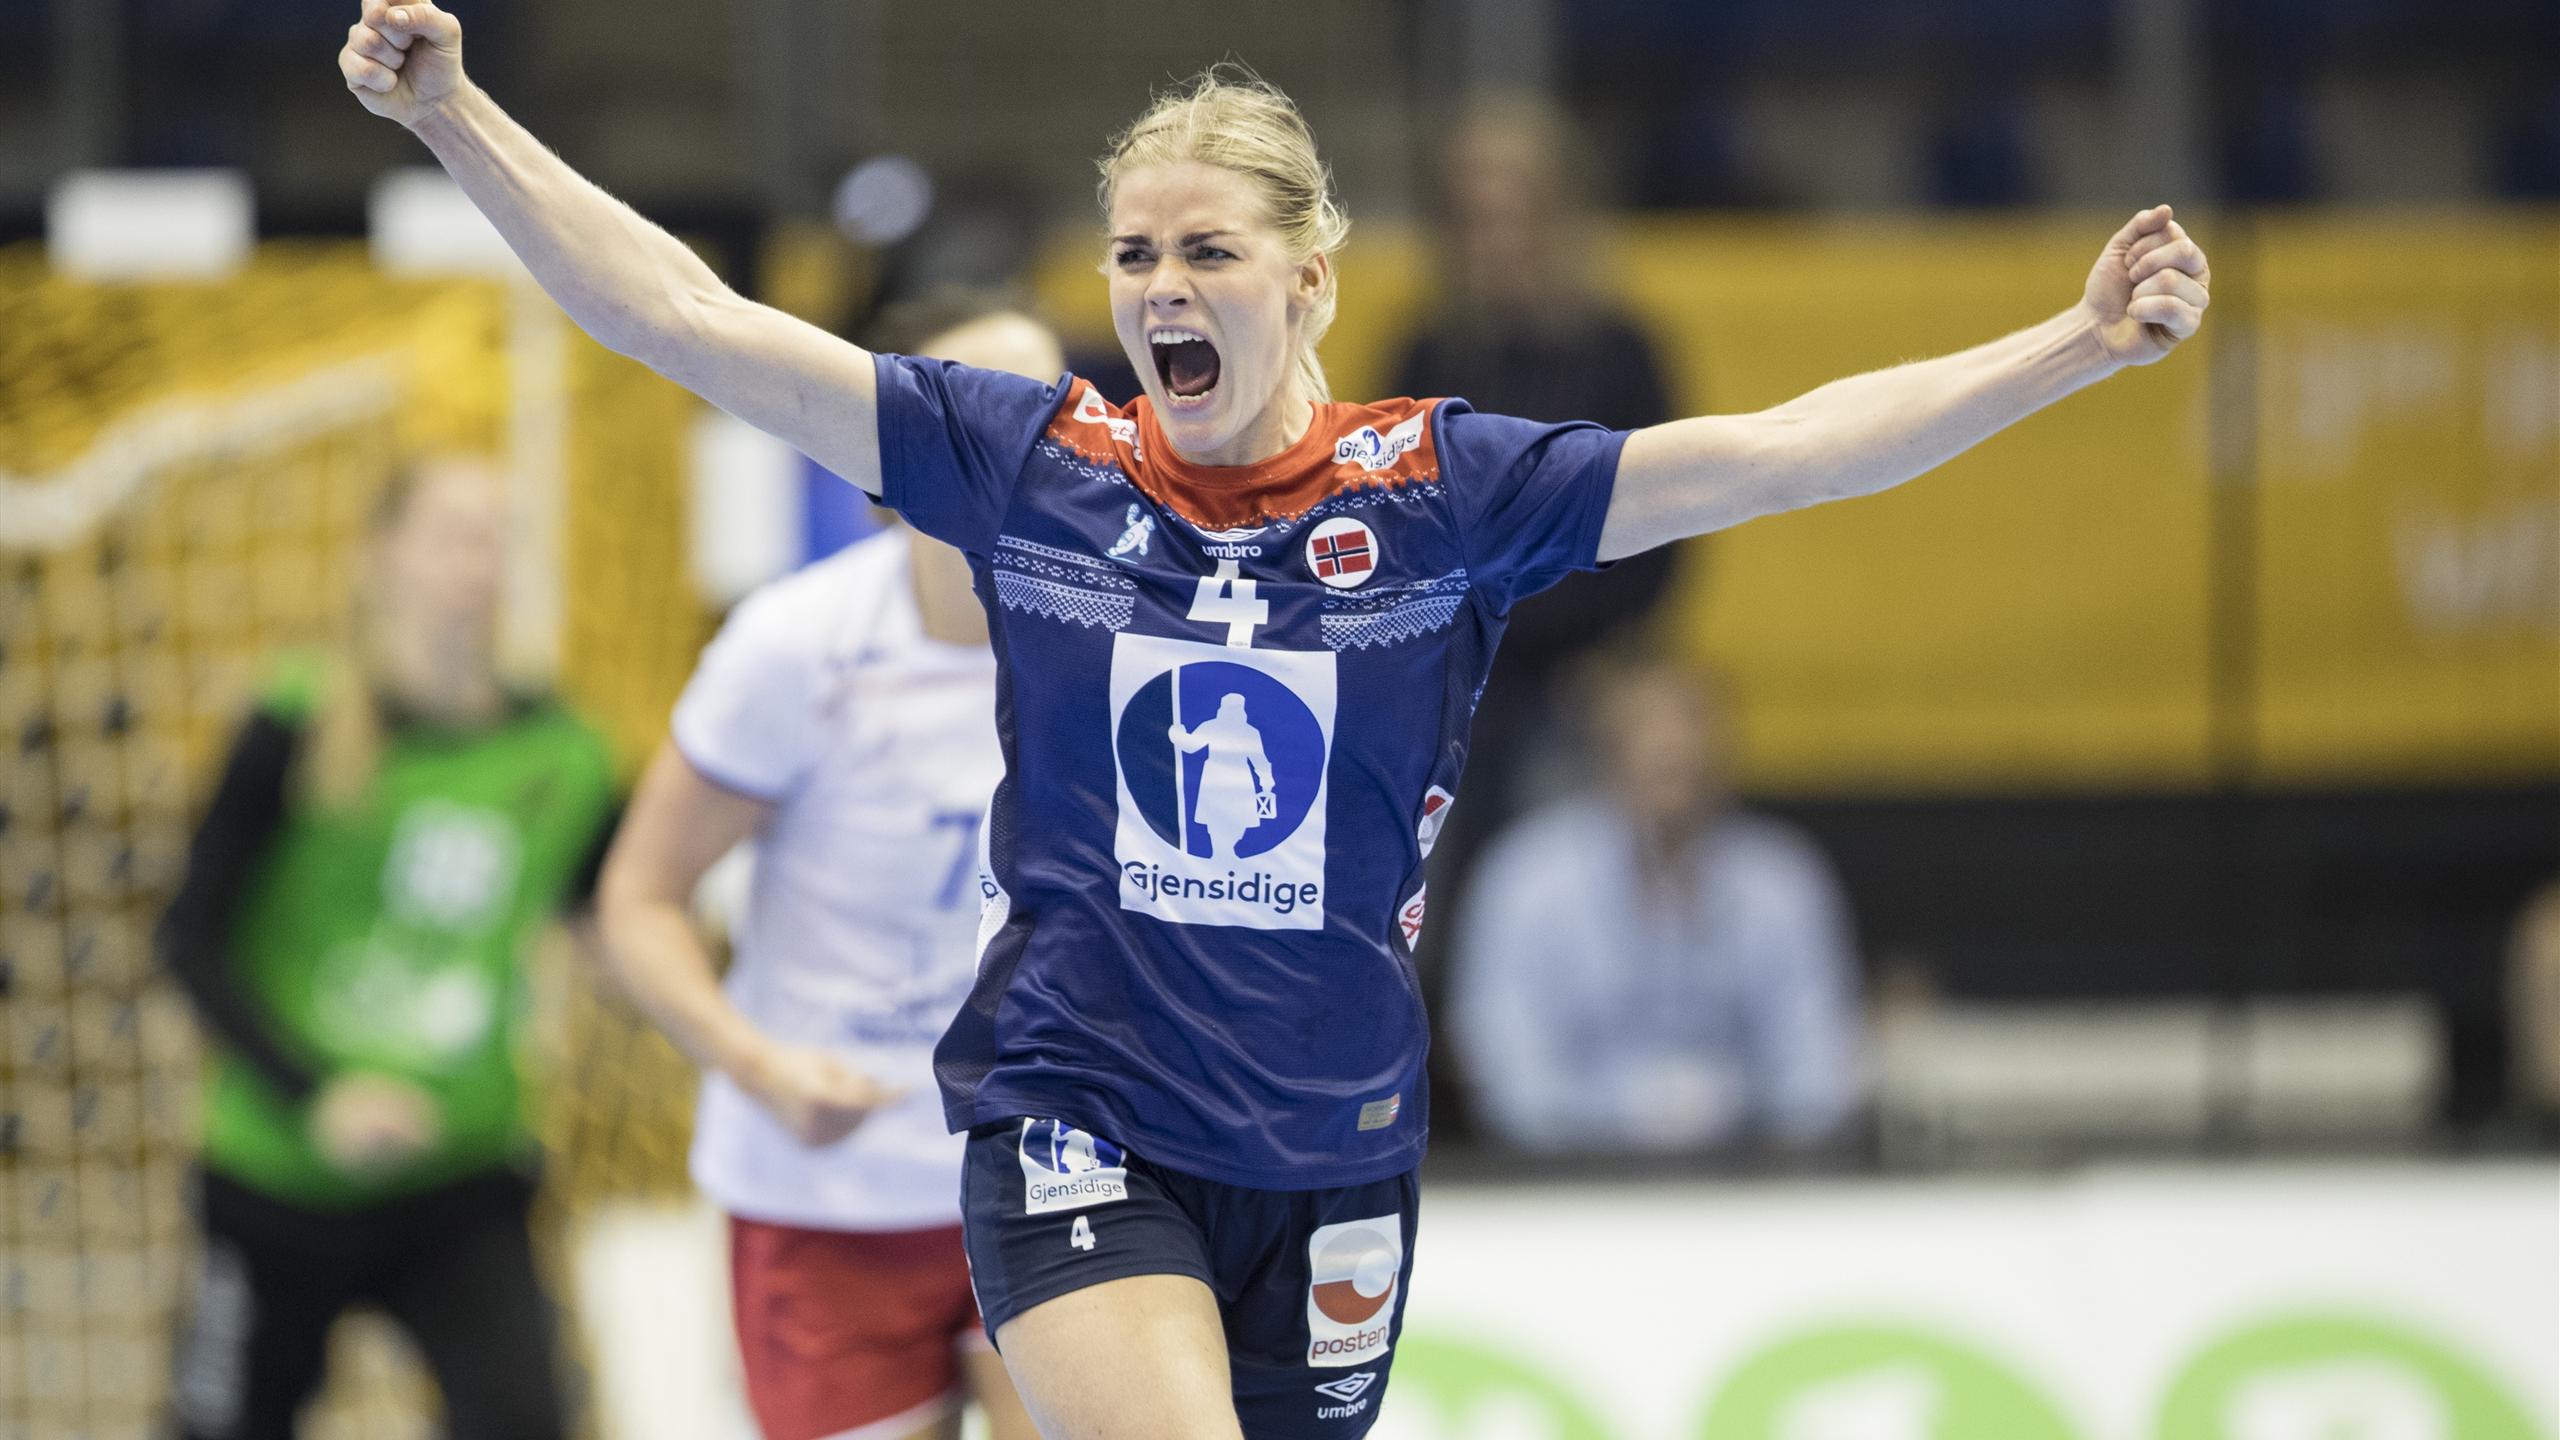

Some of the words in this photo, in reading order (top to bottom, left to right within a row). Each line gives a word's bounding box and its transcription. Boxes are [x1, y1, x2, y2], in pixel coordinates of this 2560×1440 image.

[1202, 542, 1262, 558] umbro
[1187, 559, 1268, 649] 4
[1123, 860, 1318, 914] Gjensidige
[1029, 1178, 1122, 1204] Gjensidige
[1070, 1215, 1096, 1251] 4
[1311, 1325, 1387, 1360] posten
[1317, 1398, 1367, 1419] umbro
